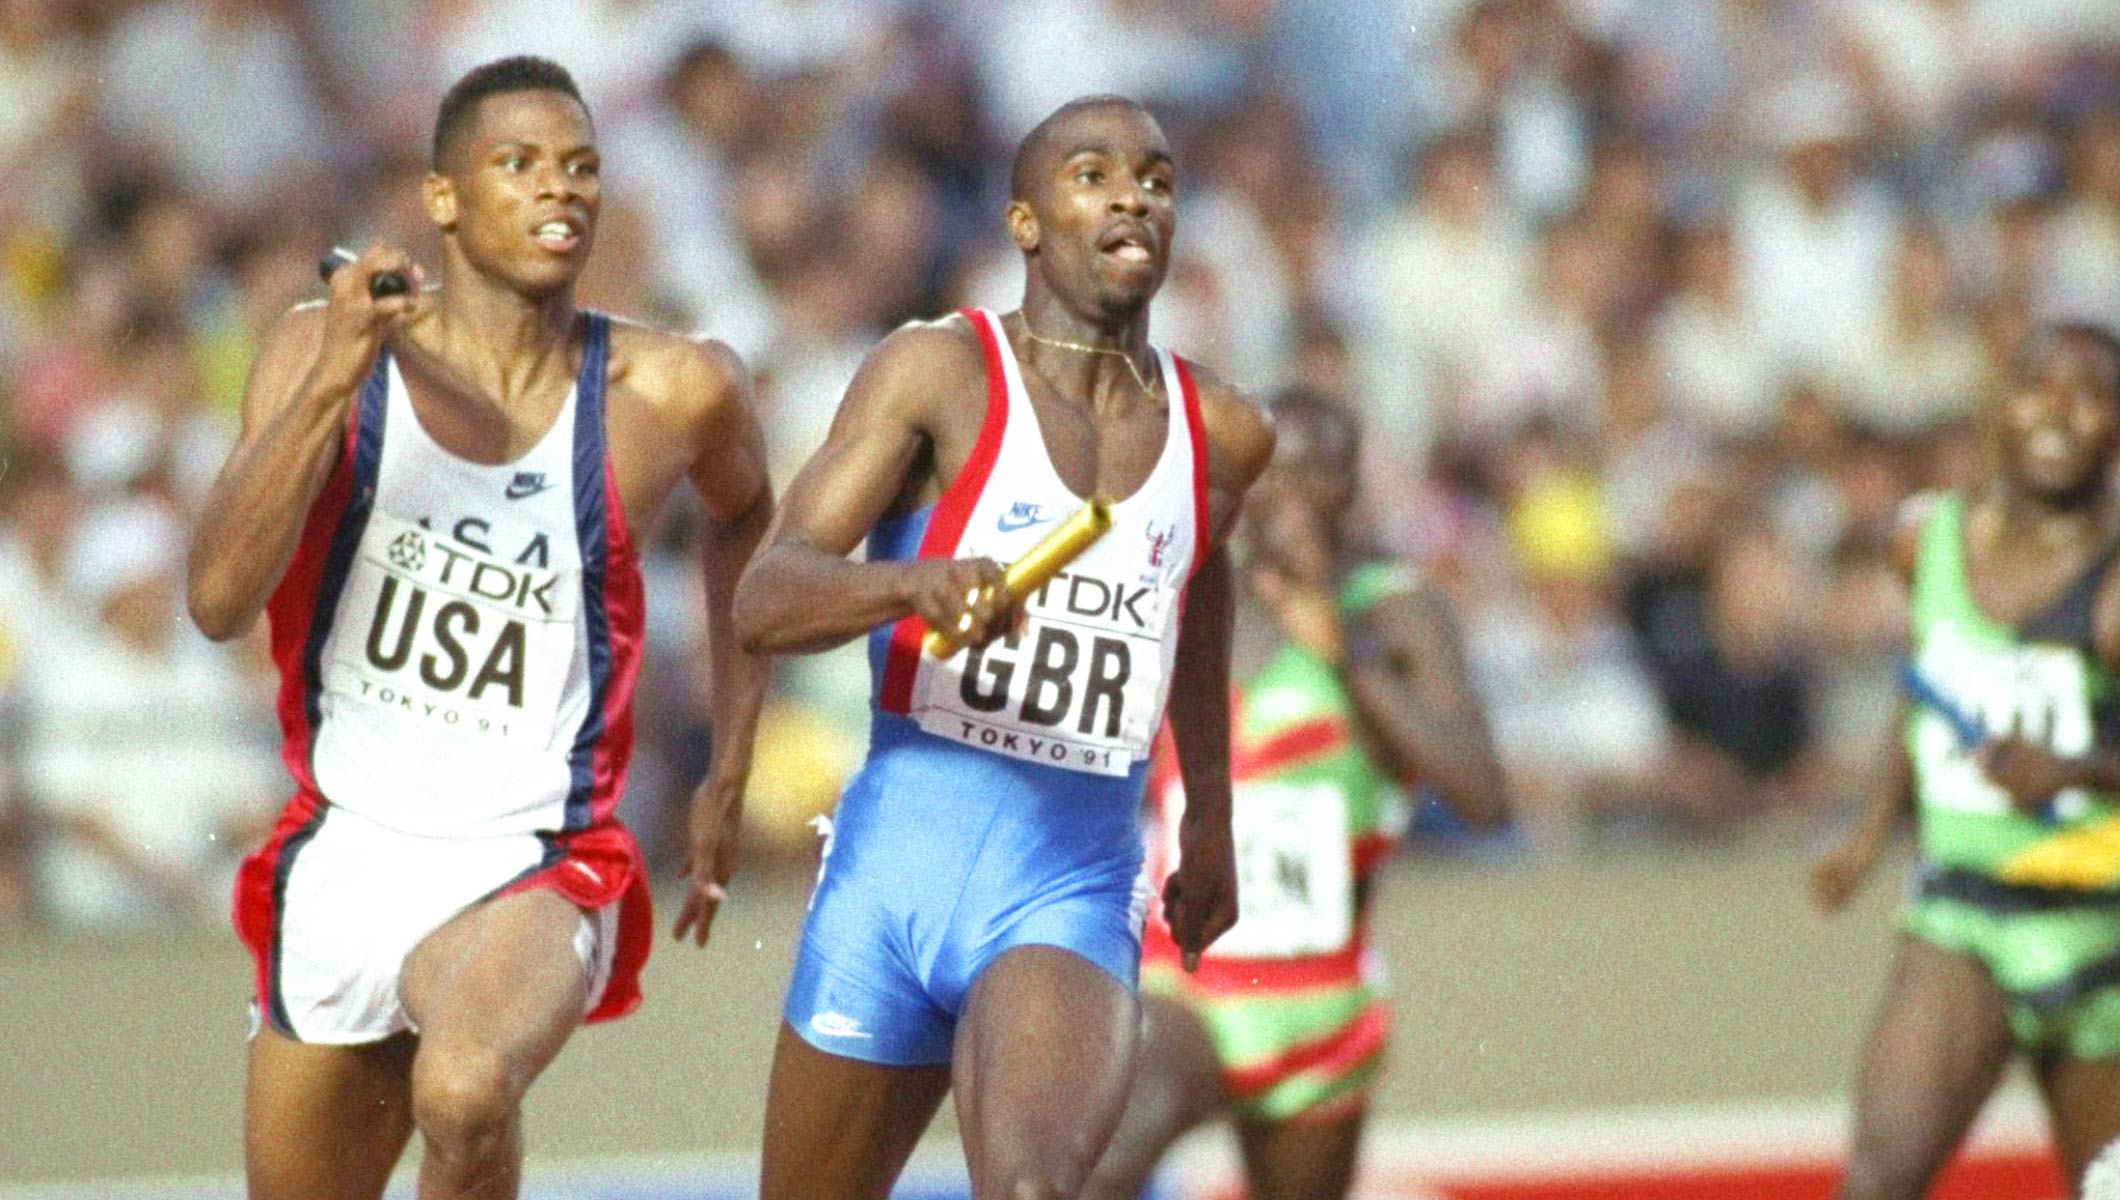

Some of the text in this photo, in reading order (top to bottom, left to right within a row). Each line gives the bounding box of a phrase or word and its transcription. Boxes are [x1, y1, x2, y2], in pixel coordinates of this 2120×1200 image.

[1008, 501, 1044, 519] NIKE
[418, 516, 550, 569] SA
[434, 541, 559, 615] TDK
[366, 575, 526, 709] USA
[361, 681, 460, 724] TOKYO
[959, 625, 1131, 738] GBR
[961, 721, 1067, 760] TOKYO
